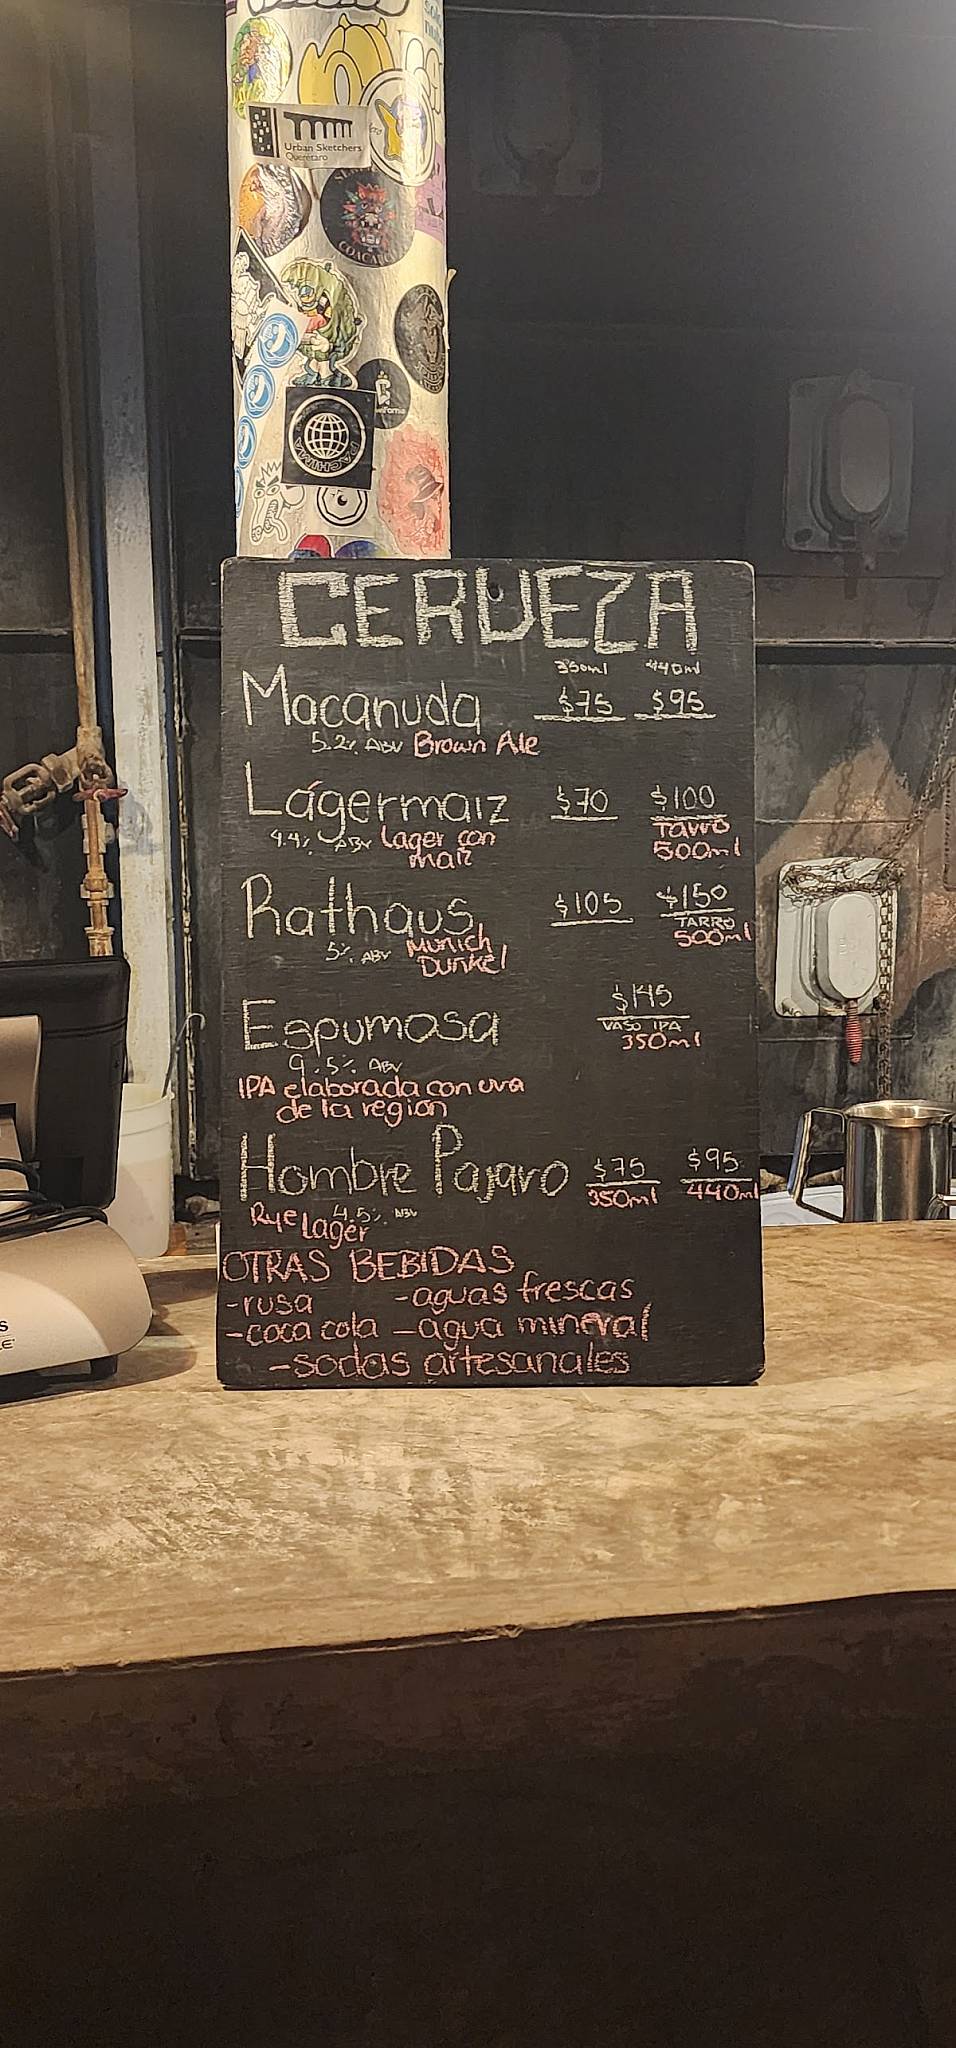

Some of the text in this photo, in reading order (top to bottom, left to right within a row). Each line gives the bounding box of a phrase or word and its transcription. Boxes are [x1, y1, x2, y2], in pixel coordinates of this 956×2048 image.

[284, 142, 363, 153] Urban Sketchers
[294, 436, 360, 473] PACHIMA
[277, 566, 699, 655] CERVEZA
[554, 659, 608, 675] 350ml
[645, 659, 701, 676] 440ml
[241, 664, 482, 736] Macanuda
[558, 686, 613, 717] $75
[652, 688, 705, 717] $95
[413, 729, 541, 758] Brown Ale
[556, 785, 609, 816] $70
[650, 784, 716, 811] $100
[457, 830, 497, 847] con
[652, 818, 731, 839] Tarro
[653, 836, 742, 862] 500ml
[241, 873, 475, 939] Rathaus
[554, 891, 624, 919] $105
[656, 883, 728, 910] $150
[674, 922, 752, 948] 500ml
[675, 916, 736, 930] TARRO
[611, 984, 673, 1015] $145
[242, 998, 501, 1058] Espumosa
[602, 1020, 683, 1033] VASO IPA
[621, 1031, 702, 1051] 350ml
[238, 1074, 526, 1100] IPA elaborada con uva
[275, 1098, 313, 1124] de
[321, 1098, 354, 1119] la
[239, 1132, 417, 1202] Hombre
[592, 1158, 646, 1182] $75
[687, 1147, 740, 1173] $95
[586, 1186, 660, 1209] 350ml
[686, 1182, 760, 1201] 440ml
[250, 1201, 298, 1233] Rye
[221, 1245, 517, 1284] OTRAS BEBIDAS
[516, 1270, 636, 1304] frescas
[319, 1311, 380, 1340] cola
[516, 1301, 653, 1343] mineral
[423, 1341, 631, 1378] artesanales
